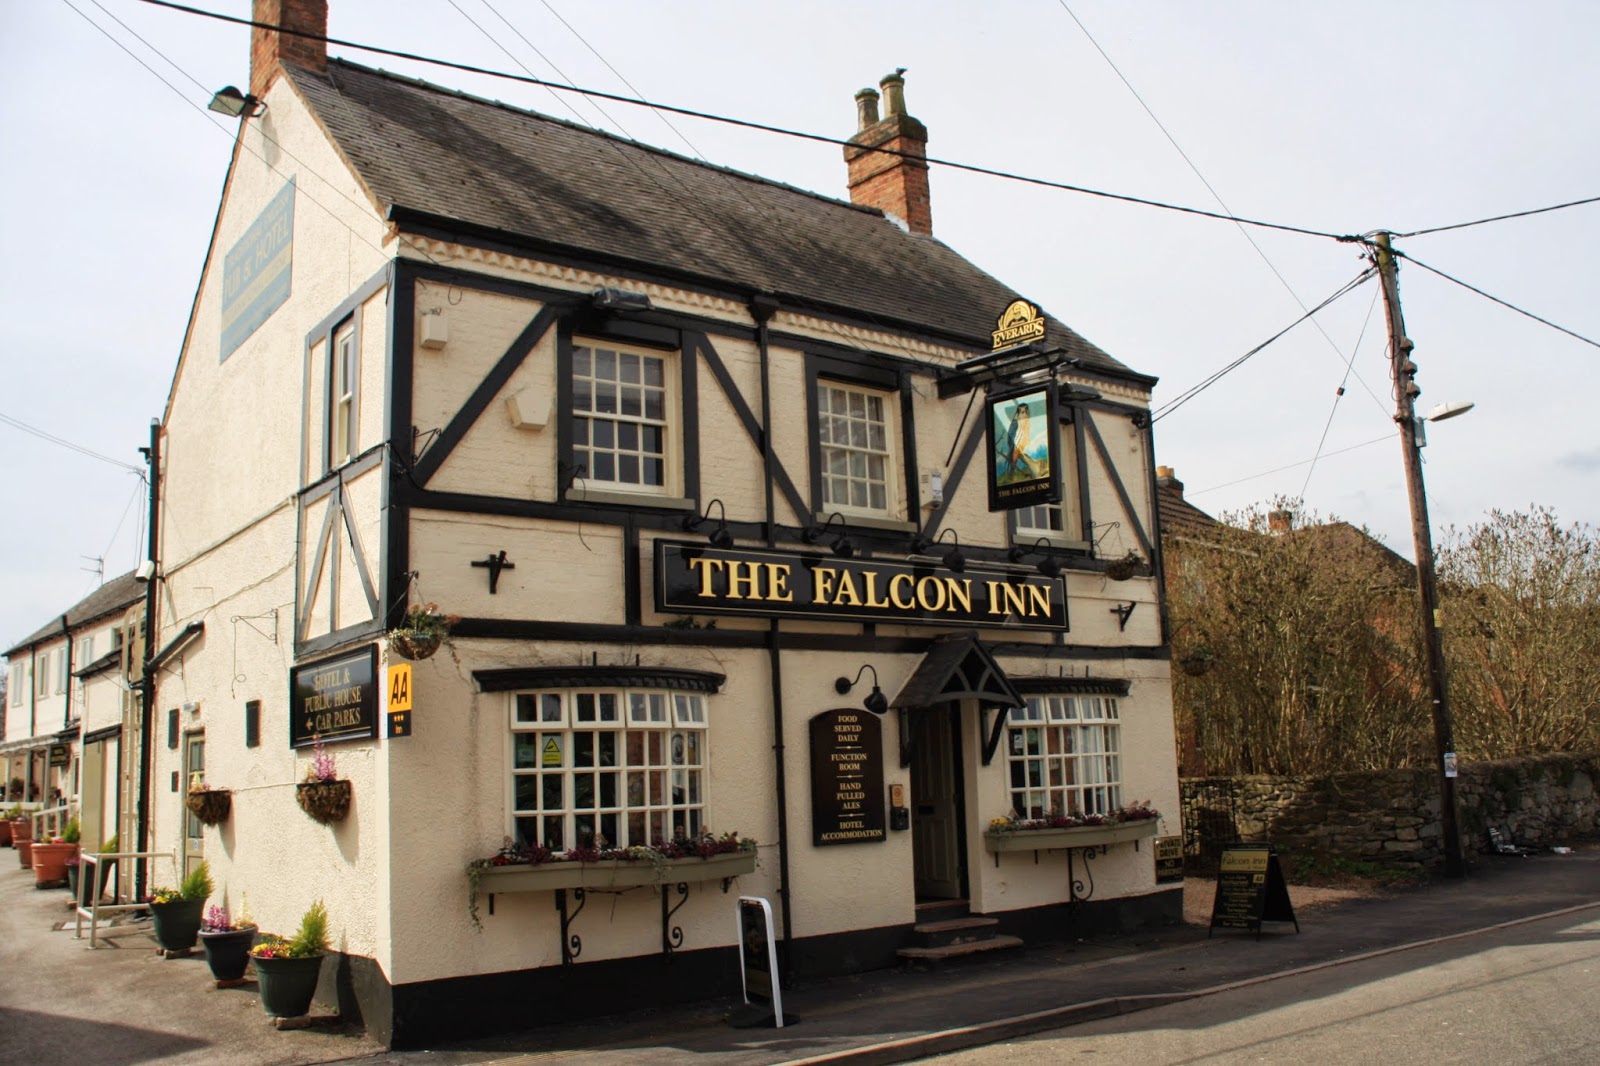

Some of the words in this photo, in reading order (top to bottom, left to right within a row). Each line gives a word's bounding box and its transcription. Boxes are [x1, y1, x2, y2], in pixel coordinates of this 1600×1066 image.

[256, 212, 289, 269] HOTEL
[992, 319, 1045, 348] EVERARDS
[1012, 485, 1036, 495] FALCON
[1038, 482, 1050, 491] INN
[690, 557, 793, 602] THE
[810, 567, 972, 613] FALCON
[986, 581, 1052, 618] INN
[315, 670, 341, 691] HOTEL
[343, 667, 351, 684] &
[391, 671, 408, 705] AA
[304, 694, 332, 713] PUBLIC
[334, 685, 362, 707] HOUSE
[315, 712, 332, 731] CAR
[334, 707, 361, 728] PARKS
[838, 715, 858, 723] FOOD
[838, 734, 859, 742] DAILY
[831, 753, 867, 761] FUNCTION
[839, 763, 860, 771] ROOM
[840, 782, 861, 790] HAND
[837, 792, 865, 800] PULLED
[843, 802, 860, 810] ALES
[840, 821, 864, 829] HOTEL
[820, 829, 883, 840] ACCOMMODATION
